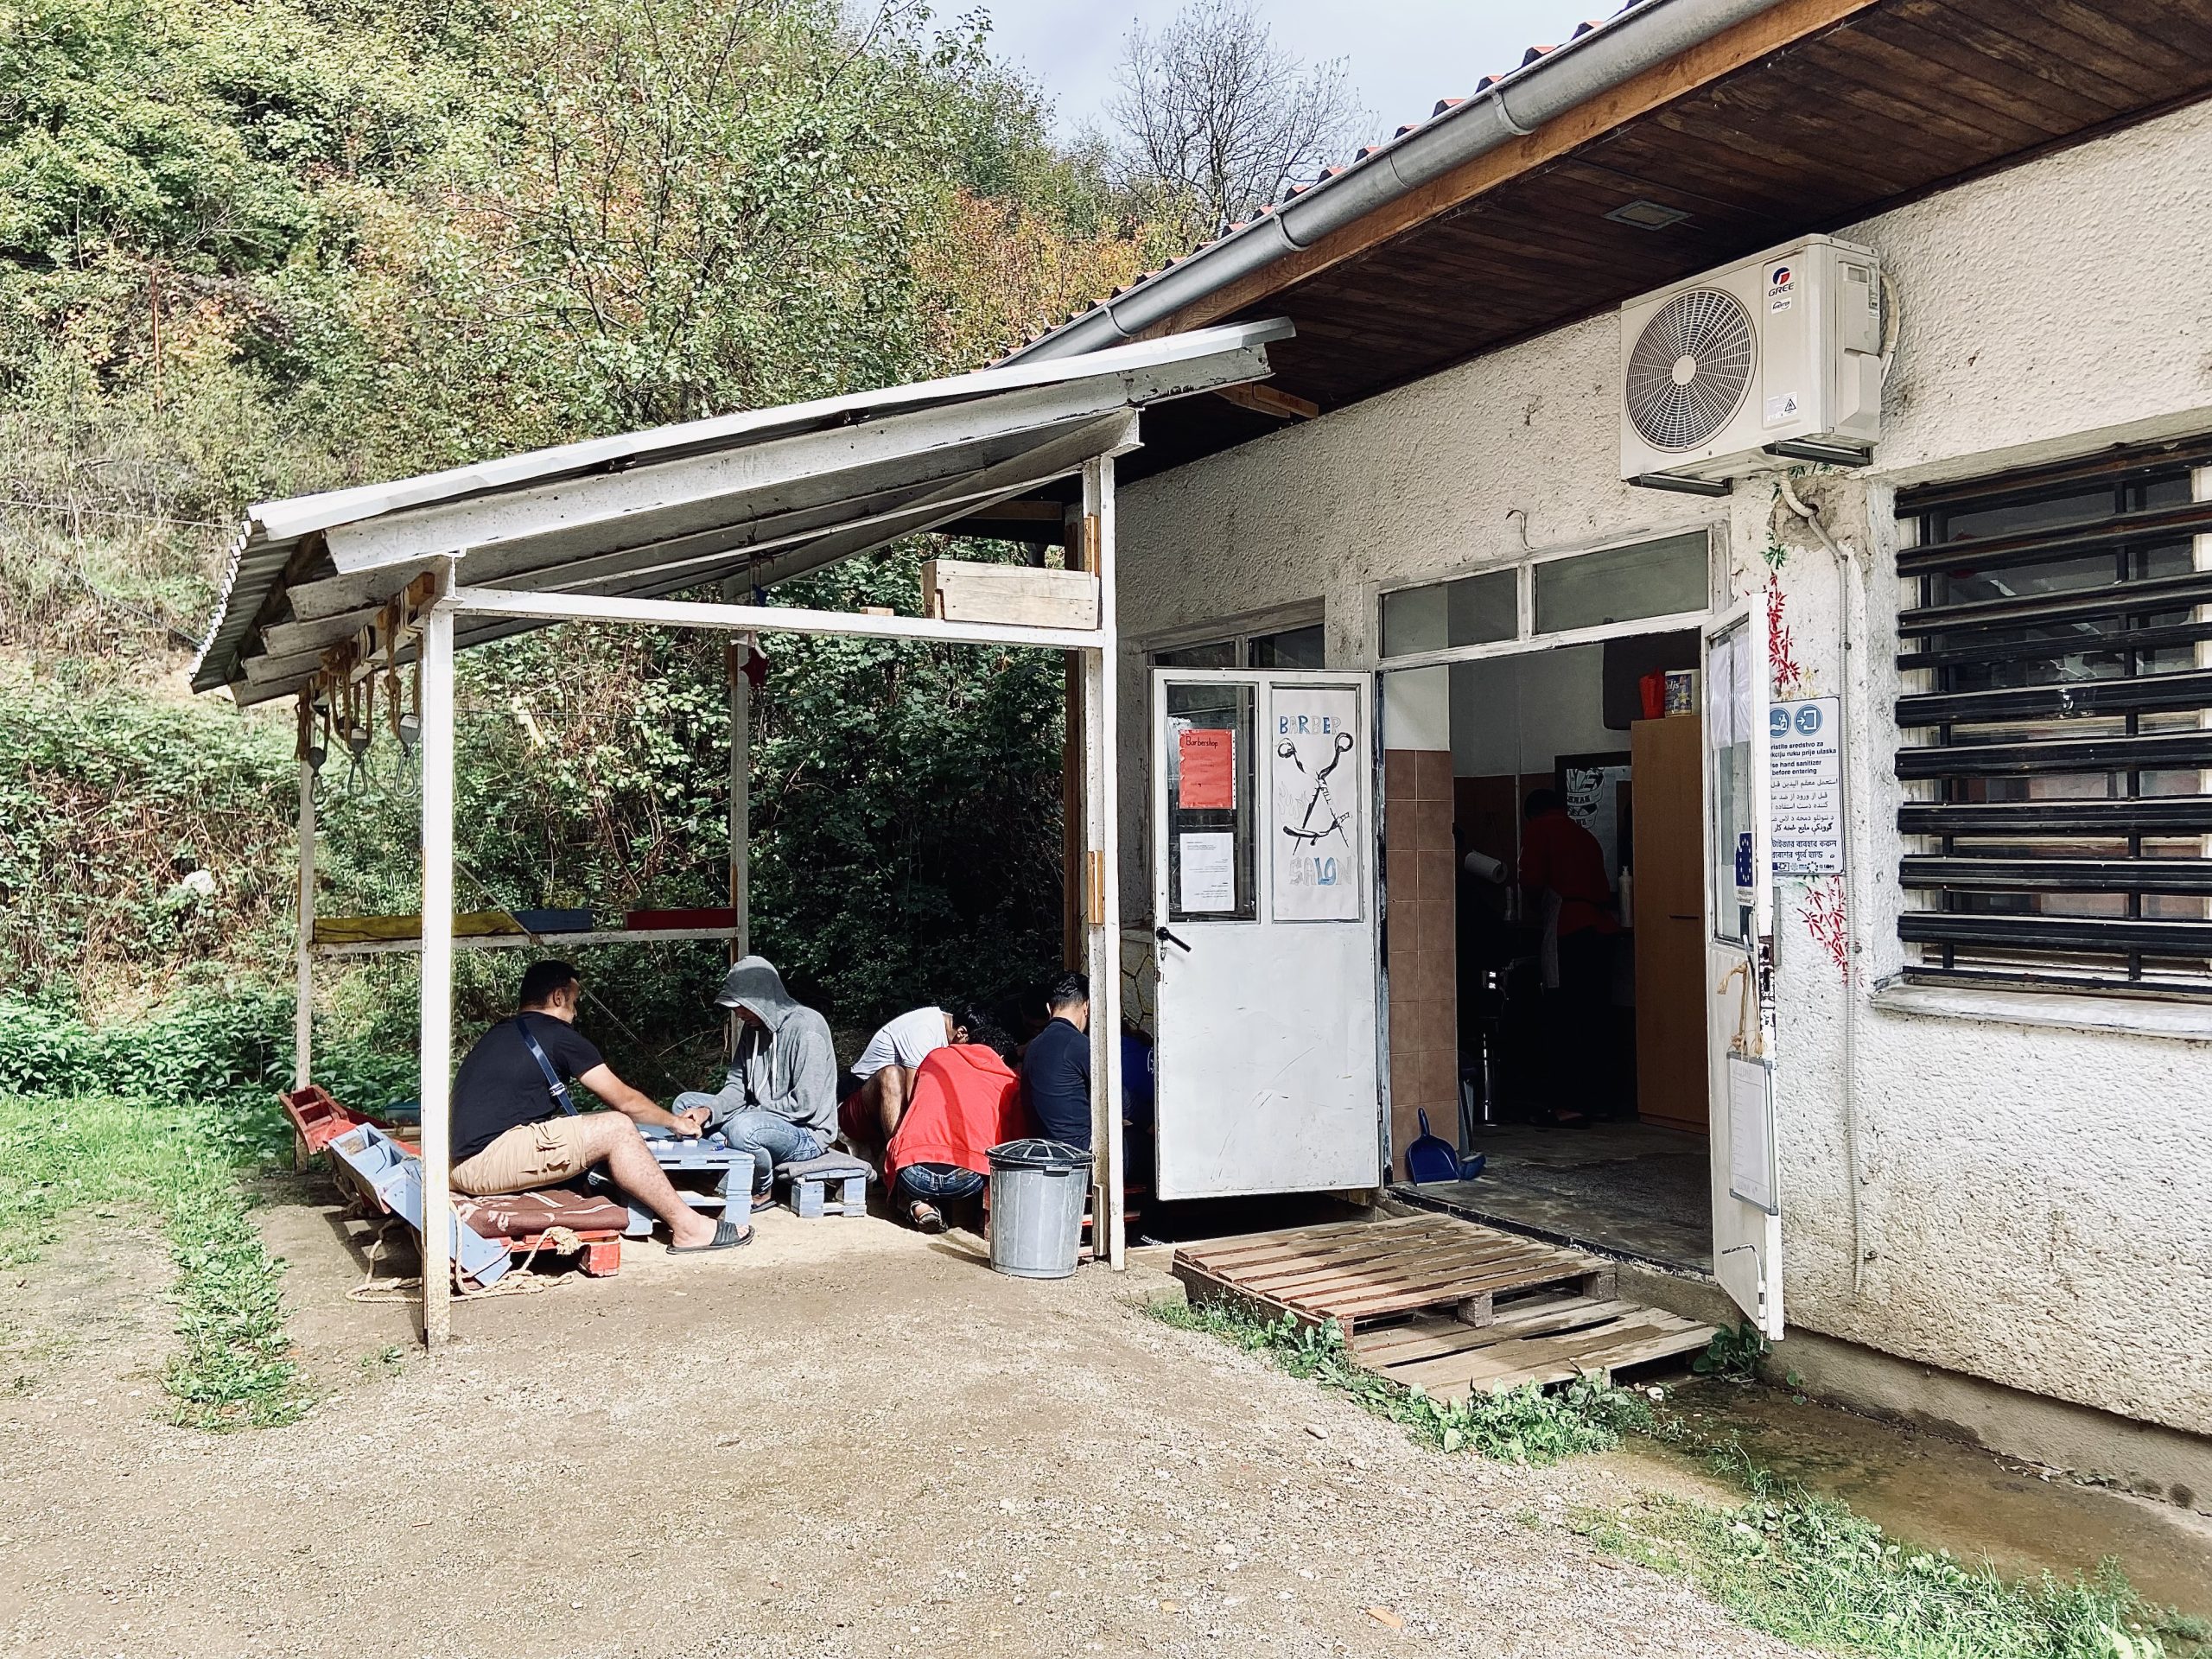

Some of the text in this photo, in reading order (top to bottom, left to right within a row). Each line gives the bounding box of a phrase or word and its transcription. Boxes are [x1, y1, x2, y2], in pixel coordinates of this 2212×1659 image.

[1768, 282, 1795, 297] GREE
[1280, 715, 1342, 735] BARBER
[1185, 736, 1218, 749] Barbershop
[1289, 855, 1352, 886] SALON
